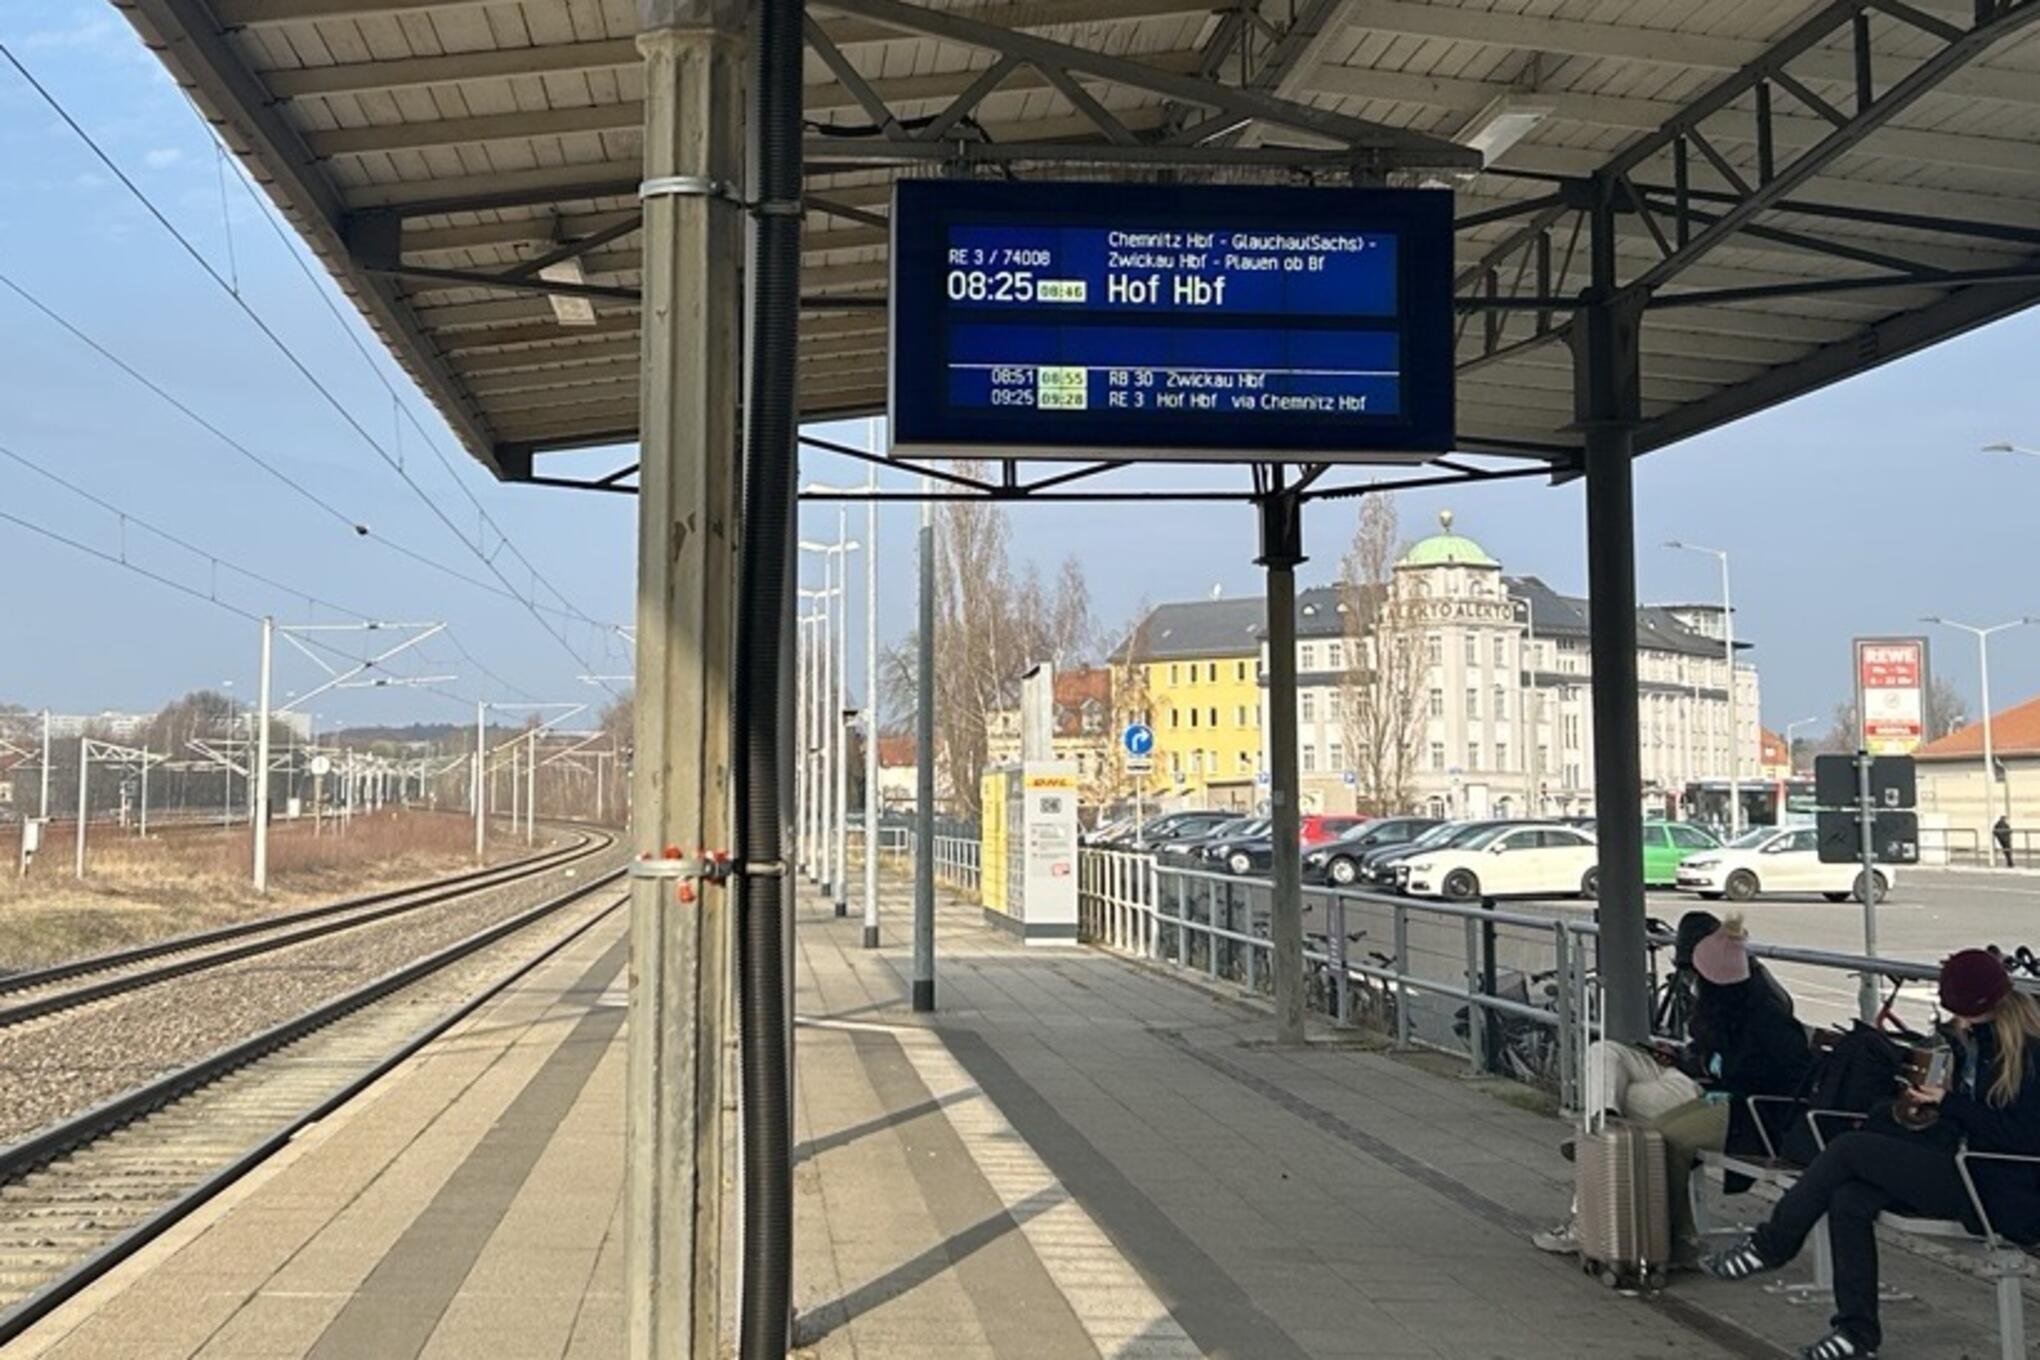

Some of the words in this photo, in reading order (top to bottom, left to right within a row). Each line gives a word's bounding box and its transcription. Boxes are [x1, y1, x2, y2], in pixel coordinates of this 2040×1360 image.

[1108, 231, 1181, 249] Chemnitz
[1186, 233, 1214, 249] Hbf
[949, 249, 969, 265] RE
[973, 249, 984, 265] 3
[988, 249, 998, 265] /
[1003, 249, 1051, 266] 74008
[1108, 251, 1175, 268] Zwickau
[1179, 253, 1207, 269] Hbf
[1224, 254, 1278, 270] Plauen
[1283, 255, 1303, 271] ob
[1308, 255, 1325, 271] Bf
[947, 271, 1034, 300] 08:25
[1108, 274, 1160, 304] Hof
[1174, 275, 1226, 305] Hbf
[991, 368, 1034, 385] 08:51
[1108, 371, 1128, 387] RB
[1134, 371, 1153, 387] 30
[1166, 371, 1233, 388] Zwickau
[1238, 373, 1266, 388] Hbf
[991, 389, 1034, 405] 09:25
[1108, 391, 1128, 407] RE
[1134, 391, 1144, 407] 3
[1156, 392, 1186, 408] Hof
[1189, 392, 1218, 408] Hbf
[1231, 394, 1256, 409] via
[1260, 393, 1334, 410] Chemnitz
[1338, 395, 1367, 410] Hbf
